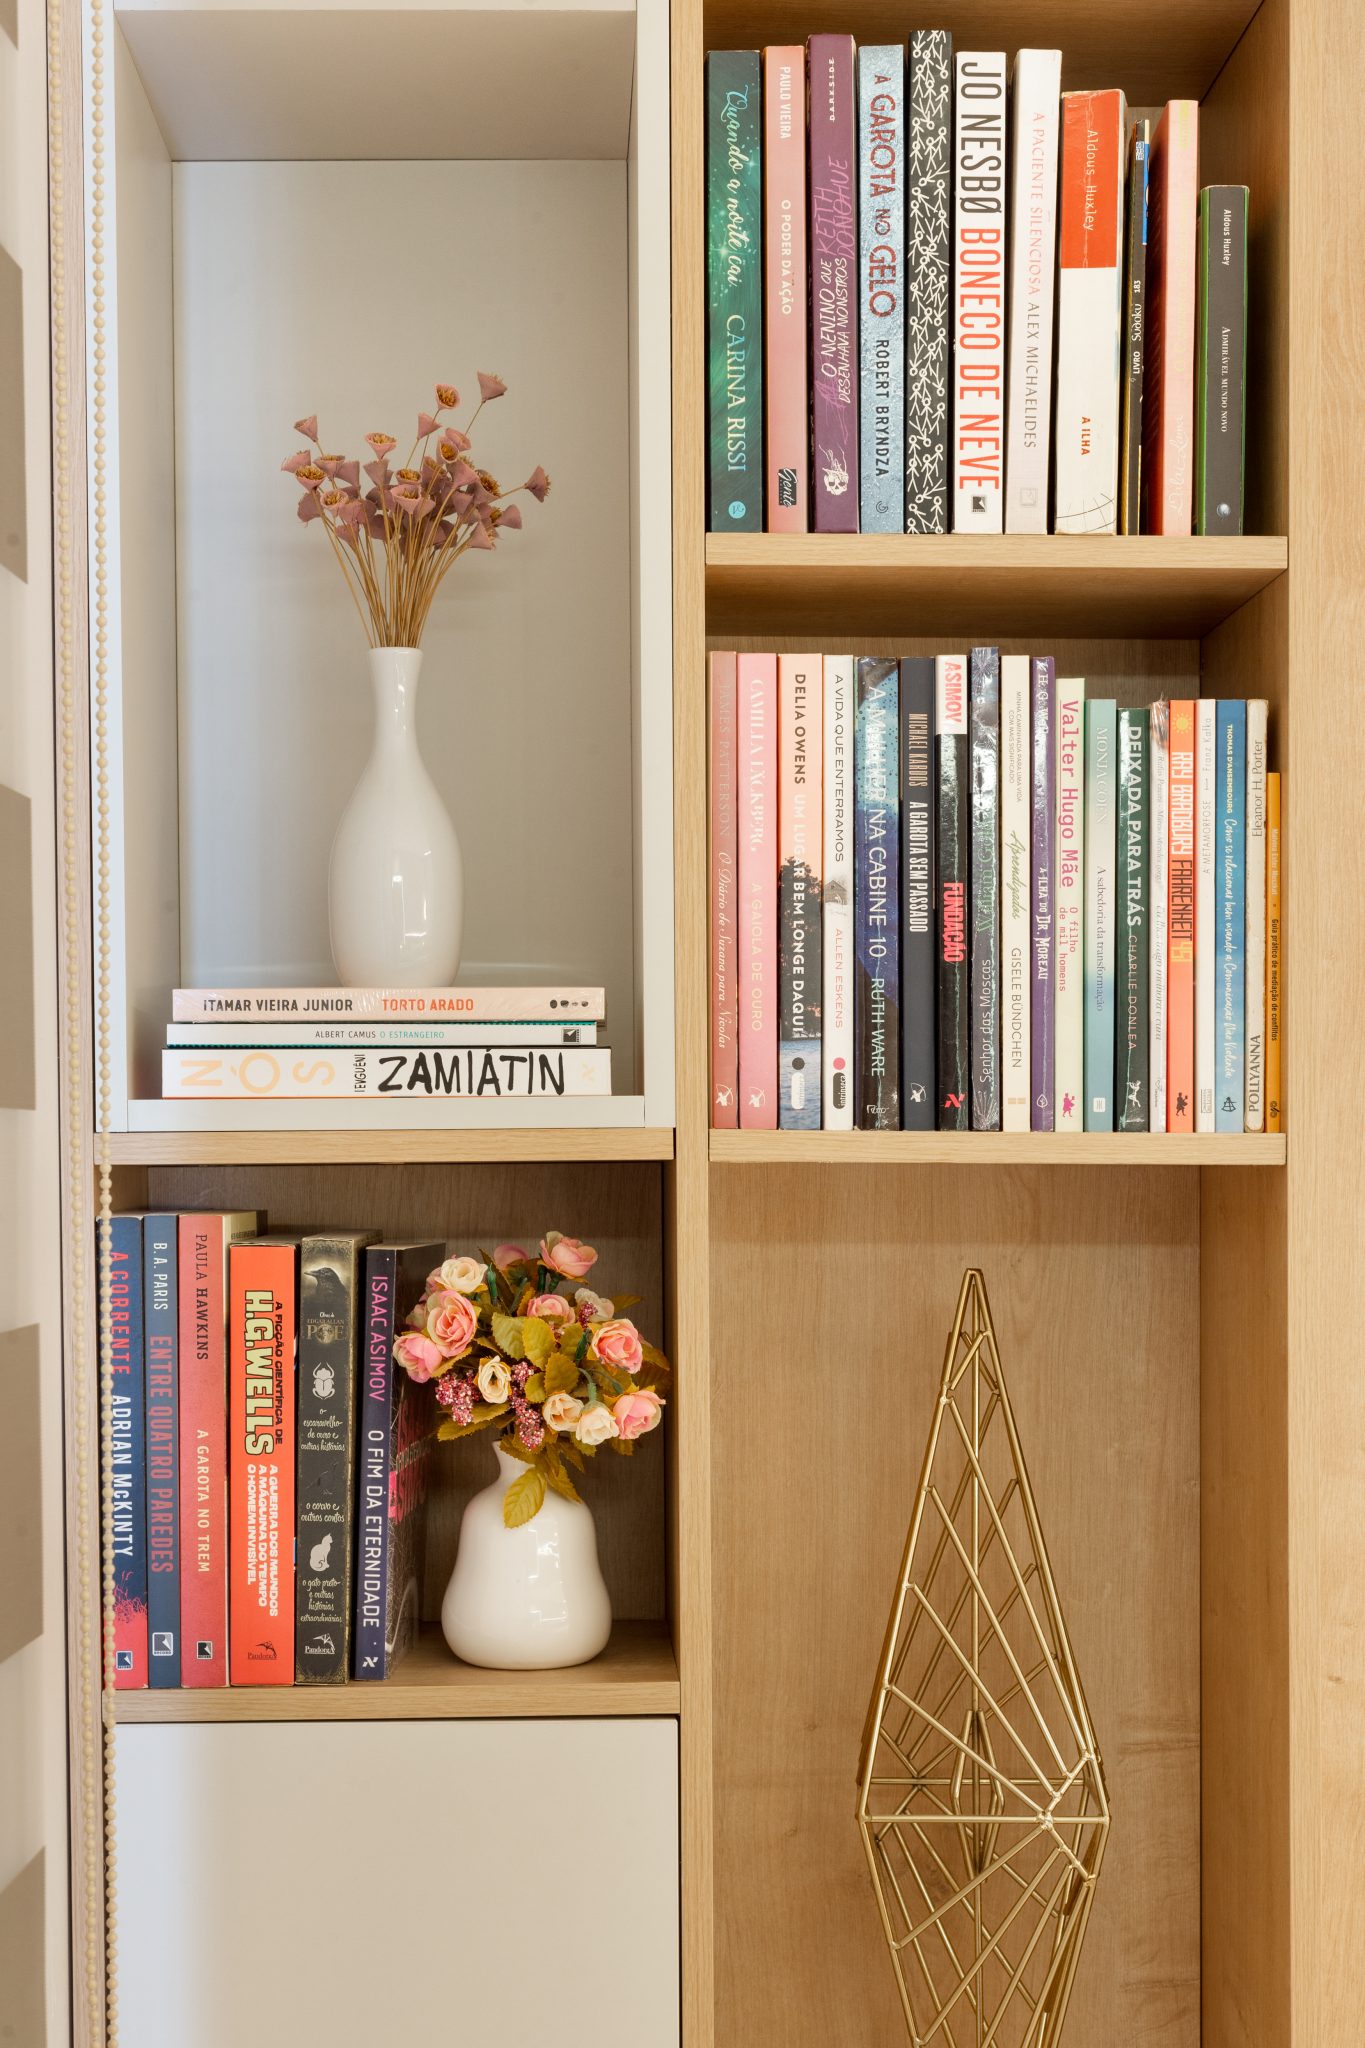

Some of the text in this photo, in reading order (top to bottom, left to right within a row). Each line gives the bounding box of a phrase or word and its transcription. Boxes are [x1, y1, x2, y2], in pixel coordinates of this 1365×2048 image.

[780, 67, 791, 138] PAULO VIEIRA
[960, 62, 1002, 213] JO NESBØ
[721, 85, 750, 286] Quando a noite cai
[869, 75, 897, 318] A GAROTA NO GELO
[1028, 112, 1044, 295] A PACIENTE SILENCIOSA
[1083, 130, 1098, 230] Aldous Huxley
[779, 200, 793, 314] O PODER DA AÇÃO
[1222, 239, 1231, 265] Huxley
[820, 258, 835, 377] O MENINO QUE
[835, 258, 850, 403] DESENHAVA MONSTROS
[960, 228, 1001, 489] BONECO DE NEVE
[1024, 302, 1040, 448] ALEX MICHAELIDES
[727, 315, 746, 472] CARINA RISSI
[876, 340, 889, 477] ROBERT BRYNDZA
[1082, 429, 1090, 455] ILHA
[795, 675, 805, 784] DELIA OWENS
[836, 675, 843, 684] A
[945, 662, 961, 722] ASIMOV
[835, 725, 843, 755] QUE
[909, 713, 927, 787] MICHAEL KARDOS
[1058, 701, 1079, 887] Valter Hugo Mãe
[1252, 740, 1262, 837] Eleanor H. Porter
[910, 801, 928, 932] A GAROTA SEM PASSADO
[1005, 830, 1027, 919] Aprendizados
[1127, 727, 1144, 926] DEIXADA PARA TRÁS
[1171, 752, 1193, 962] RAY BRADBURY FAHRENHEIT 451
[943, 883, 966, 962] FUNDAÇÃO
[1059, 907, 1068, 991] de mil homens
[1070, 921, 1078, 952] filho
[1271, 960, 1278, 968] de
[202, 998, 353, 1011] ITAMAR VIEIRA JUNIOR
[382, 999, 474, 1011] TORTO ARADO
[389, 1031, 444, 1039] ESTRANGEIRO
[872, 978, 884, 1076] RUTH WARE
[979, 960, 991, 1083] Senhor das Moscas
[1012, 948, 1023, 1068] GISELE BÜNDCHEN
[1128, 936, 1137, 1050] CHARLIE DONLEA
[1270, 970, 1278, 1001] mediação
[378, 1048, 565, 1096] ZAMIÁTIN
[1249, 1035, 1261, 1112] POLLYANNA
[154, 1243, 167, 1310] B. A. PARIS
[196, 1234, 208, 1360] PAULA HAWKINS
[275, 1301, 284, 1444] A FICÇÃO CIENTÍFICA DE
[369, 1276, 388, 1401] ISAAC ASIMOV
[111, 1252, 133, 1556] A CORRENTE ADRIAN McKINTY
[150, 1336, 173, 1572] ENTRE QUATRO PAREDES
[197, 1430, 210, 1572] A GAROTA NO TREM
[248, 1464, 257, 1585] O HOMEM INVISÍVEL
[258, 1464, 269, 1606] A MÁQUINA DO TEMPO
[269, 1464, 278, 1616] A GUERRA DOS MUNDOS
[363, 1431, 383, 1627] O FIM DA ETERNIDADE
